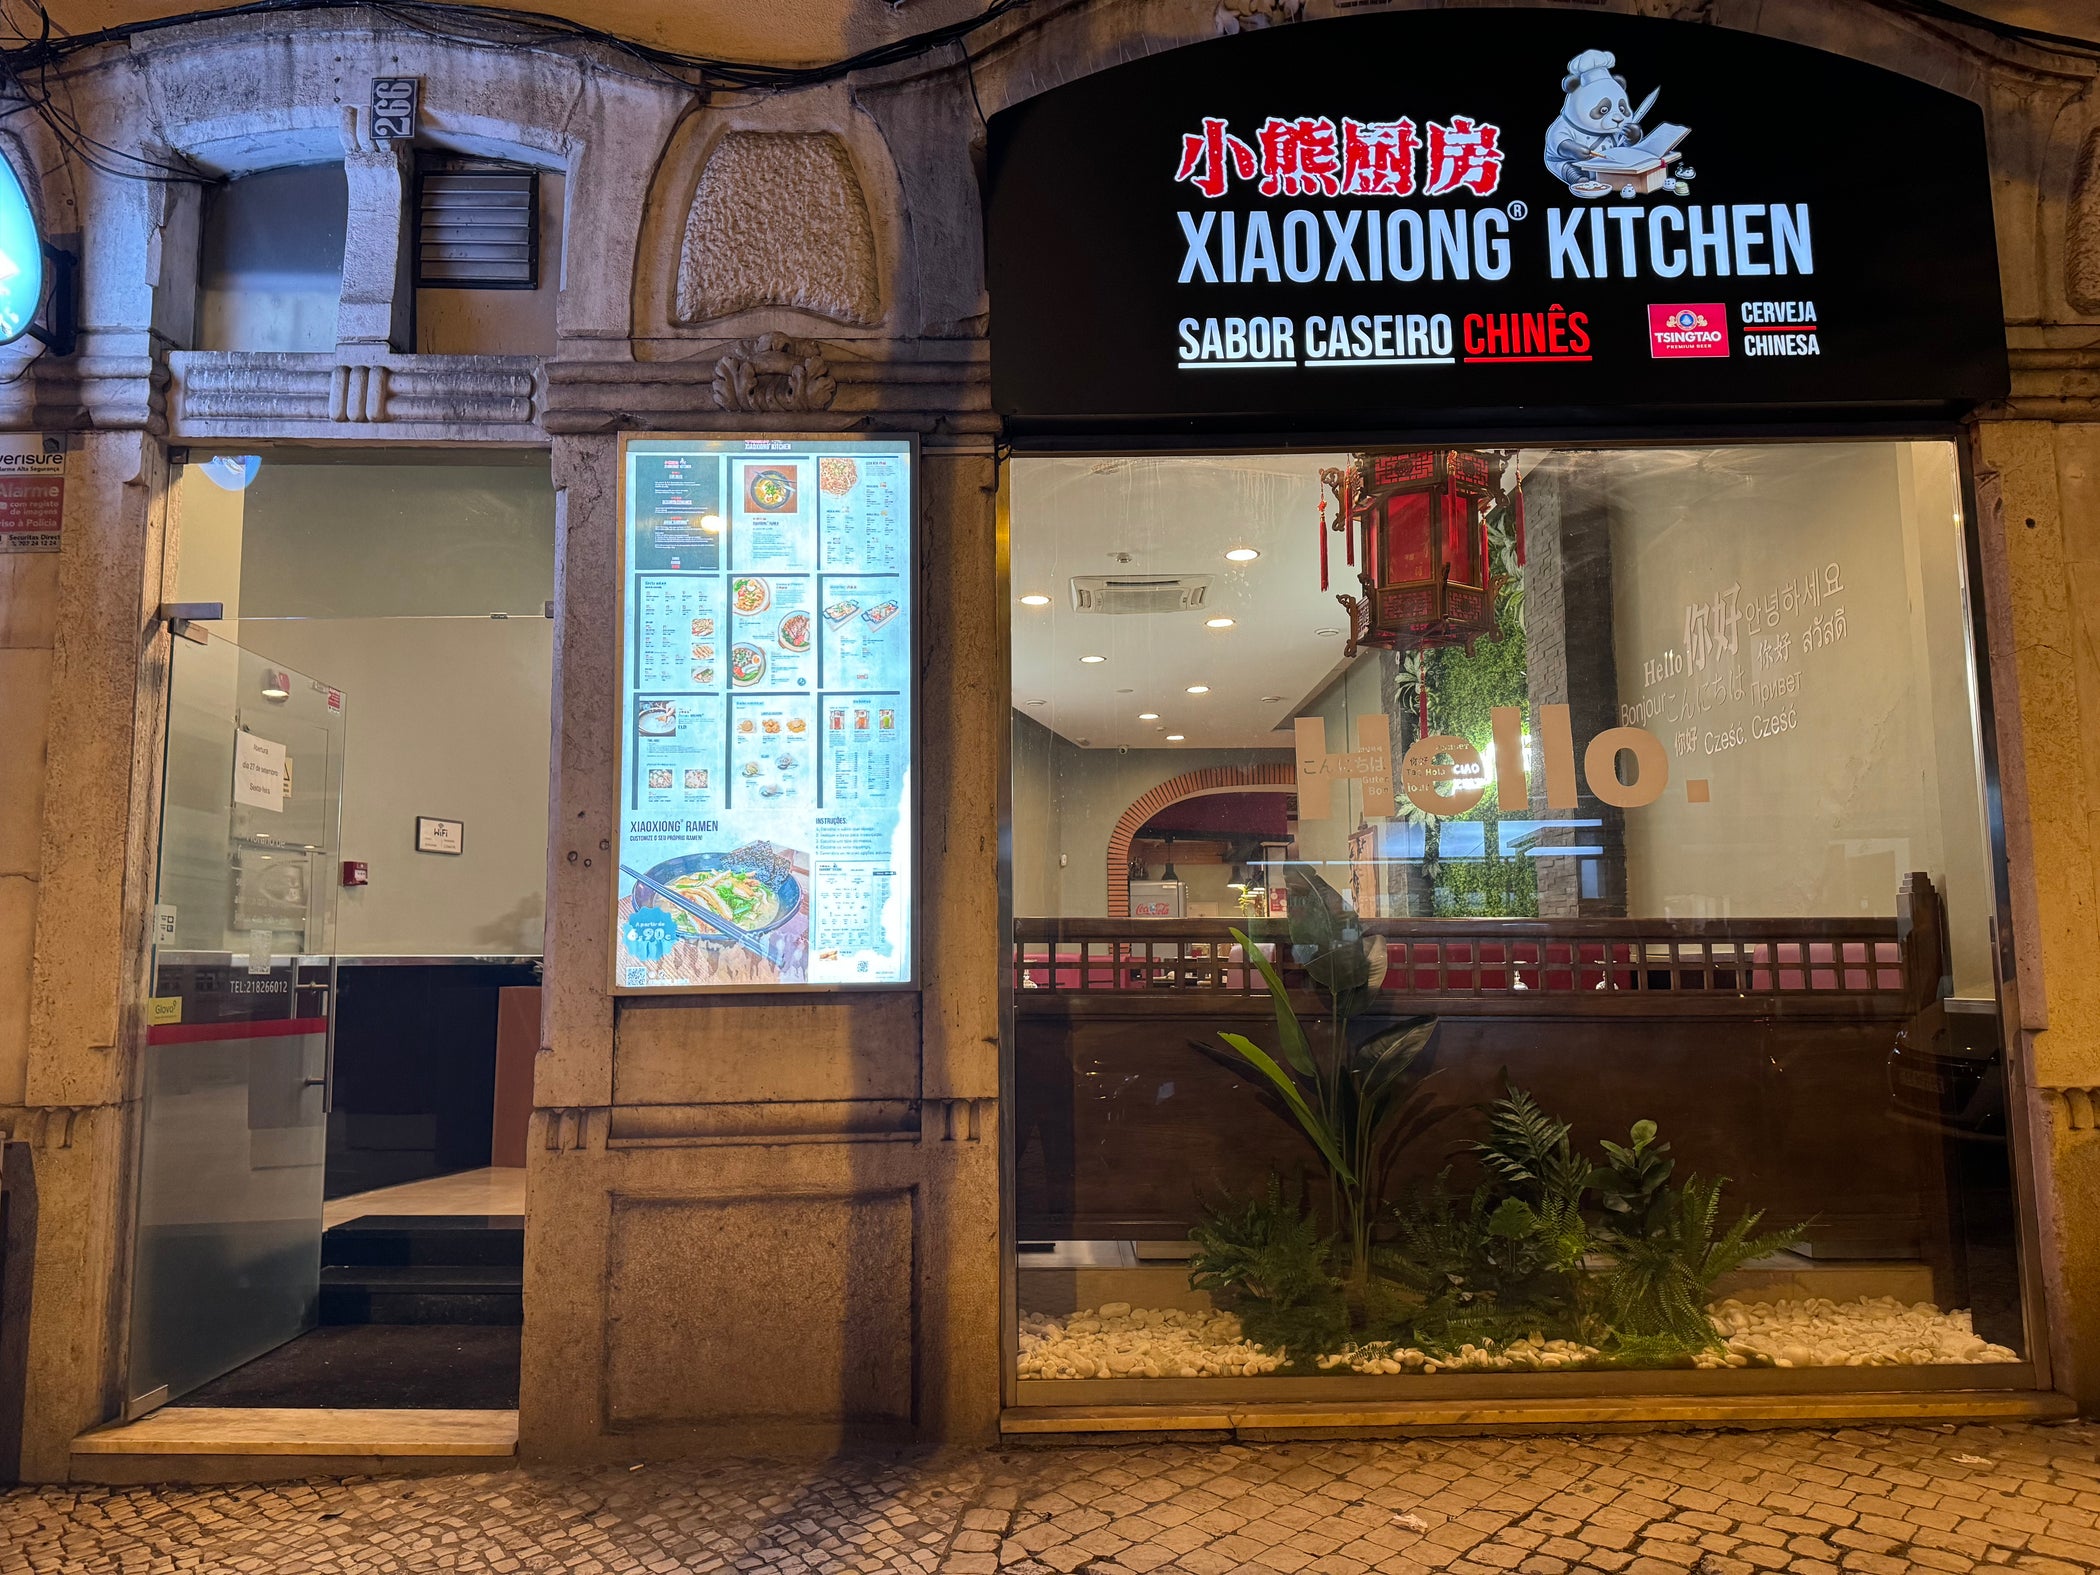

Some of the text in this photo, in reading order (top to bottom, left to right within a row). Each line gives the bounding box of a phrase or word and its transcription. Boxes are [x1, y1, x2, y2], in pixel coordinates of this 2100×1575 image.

[374, 82, 412, 136] 266
[1175, 116, 1504, 197] 小熊厨房
[1547, 203, 1814, 279] KITCHEN
[1741, 301, 1817, 323] CERVEJA
[1178, 303, 1591, 360] SABOR CASEIRO CHINÊS
[1654, 331, 1722, 343] TSINGTAO
[1744, 334, 1820, 357] CHINESA
[24, 509, 58, 517] imagens
[30, 500, 59, 508] registo
[1745, 562, 1844, 637] 안녕하세요
[1683, 580, 1743, 678] 你好
[1802, 605, 1848, 655] สวัสดี
[1643, 649, 1684, 688] Hello
[1757, 632, 1792, 672] 你好
[1667, 664, 1746, 723] こんにちは
[1751, 670, 1804, 709] Привет
[1621, 692, 1667, 728] Bonjour
[1751, 703, 1799, 740] Cześć
[1674, 726, 1698, 758] 你好
[1453, 763, 1480, 775] CIAO
[433, 827, 449, 838] WiFi
[685, 820, 719, 832] RAMEN
[230, 980, 288, 994] TEL:218266012
[154, 1002, 175, 1015] Glovo
